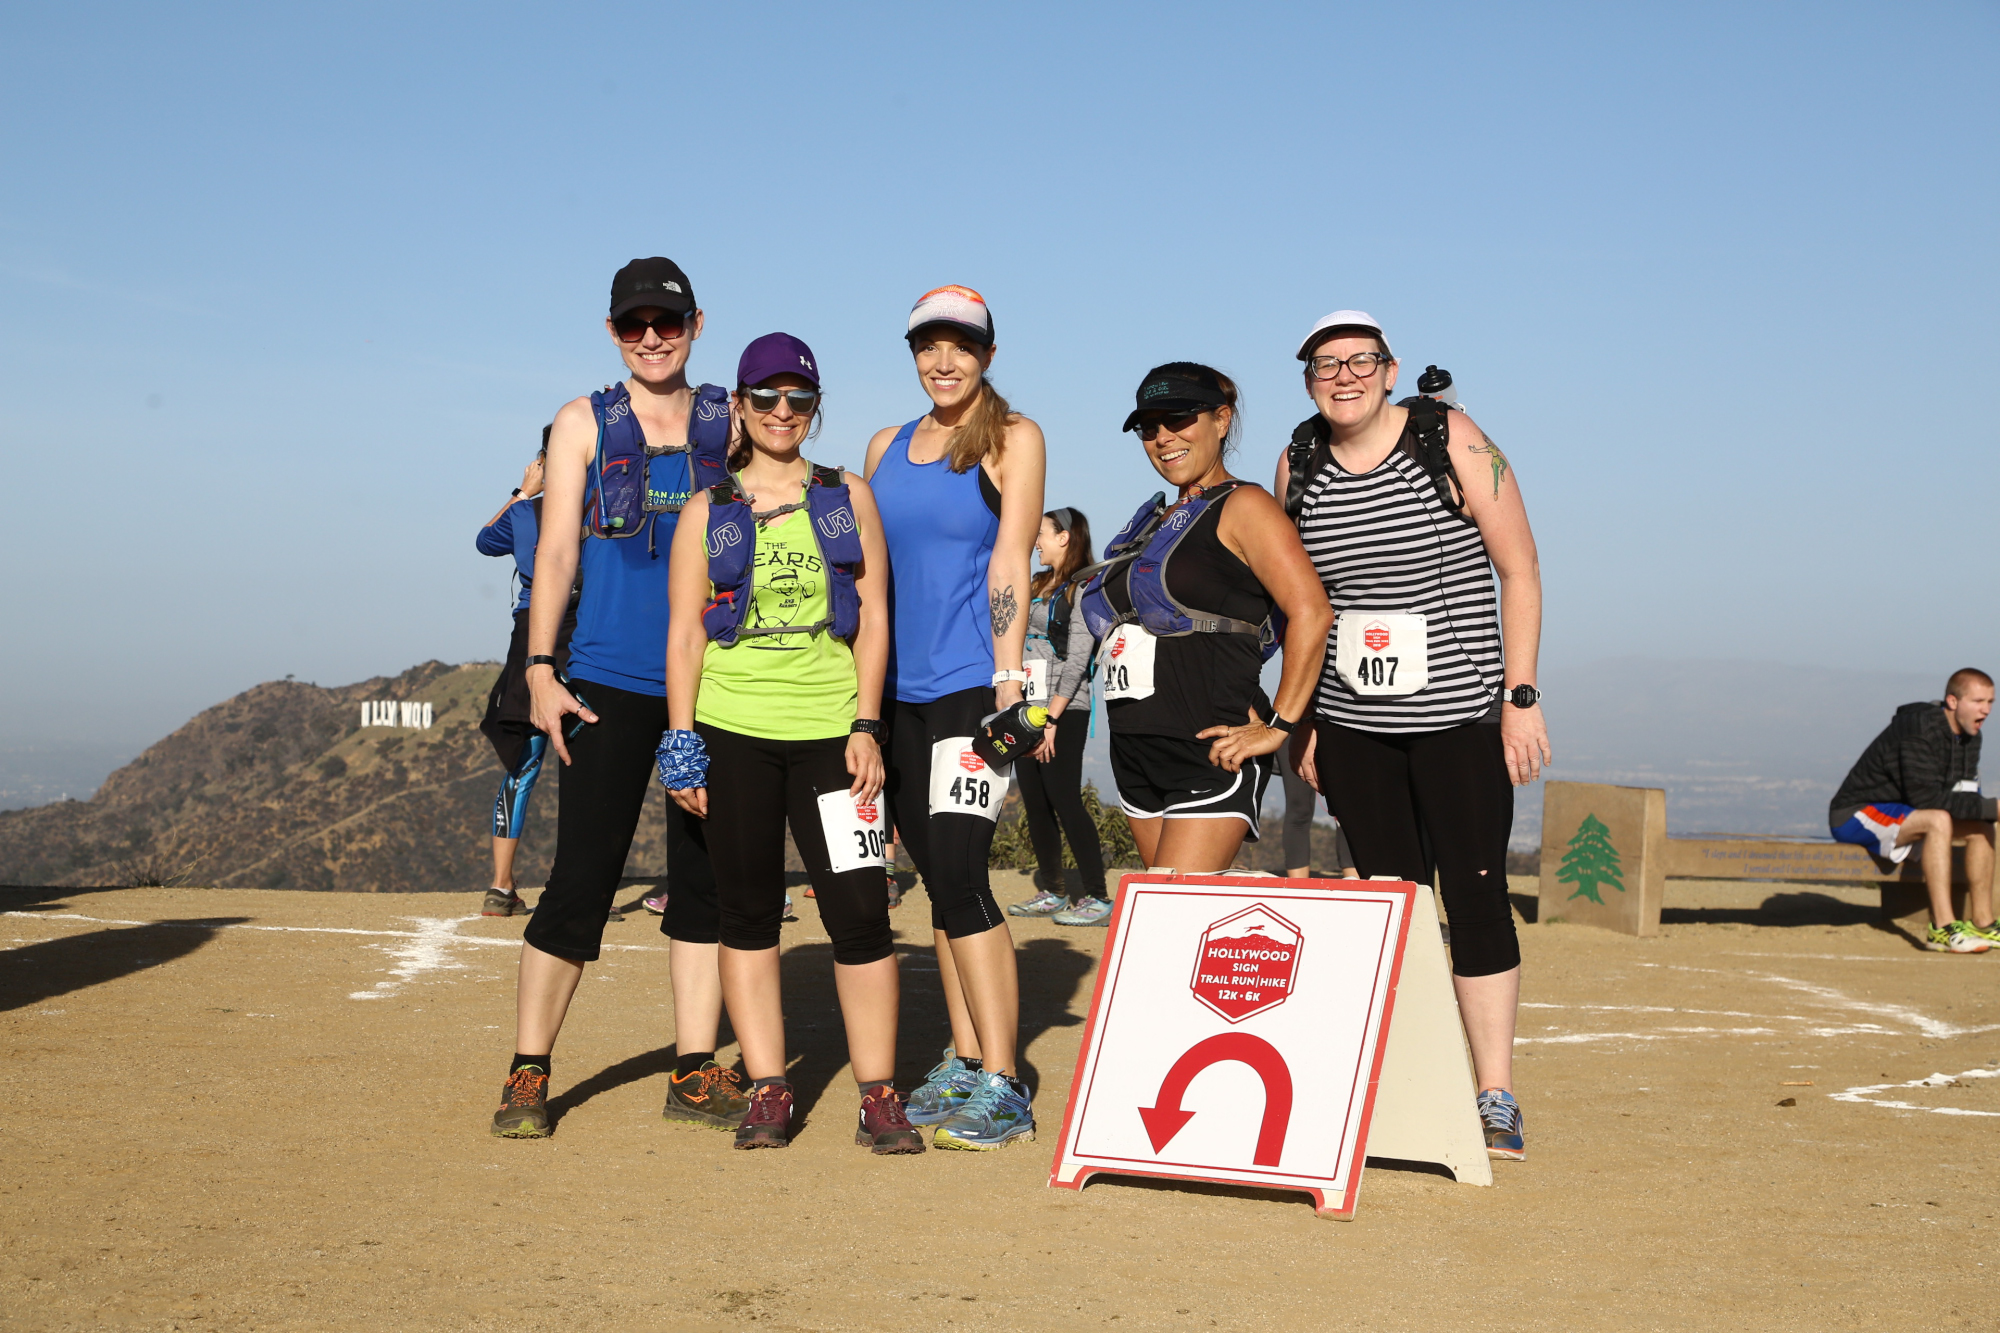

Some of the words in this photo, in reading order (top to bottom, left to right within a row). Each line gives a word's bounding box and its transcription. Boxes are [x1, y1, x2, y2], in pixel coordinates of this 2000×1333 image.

[648, 489, 667, 499] SAN
[764, 541, 788, 550] THE
[753, 551, 823, 574] EARS
[1358, 656, 1399, 687] 407
[949, 776, 990, 809] 458
[853, 829, 886, 859] 306
[1208, 947, 1290, 961] HOLLYWOOD
[1232, 963, 1260, 973] SIGN
[1200, 974, 1229, 985] TRAIL
[1218, 990, 1238, 1001] 12K
[1245, 991, 1261, 1002] 6K
